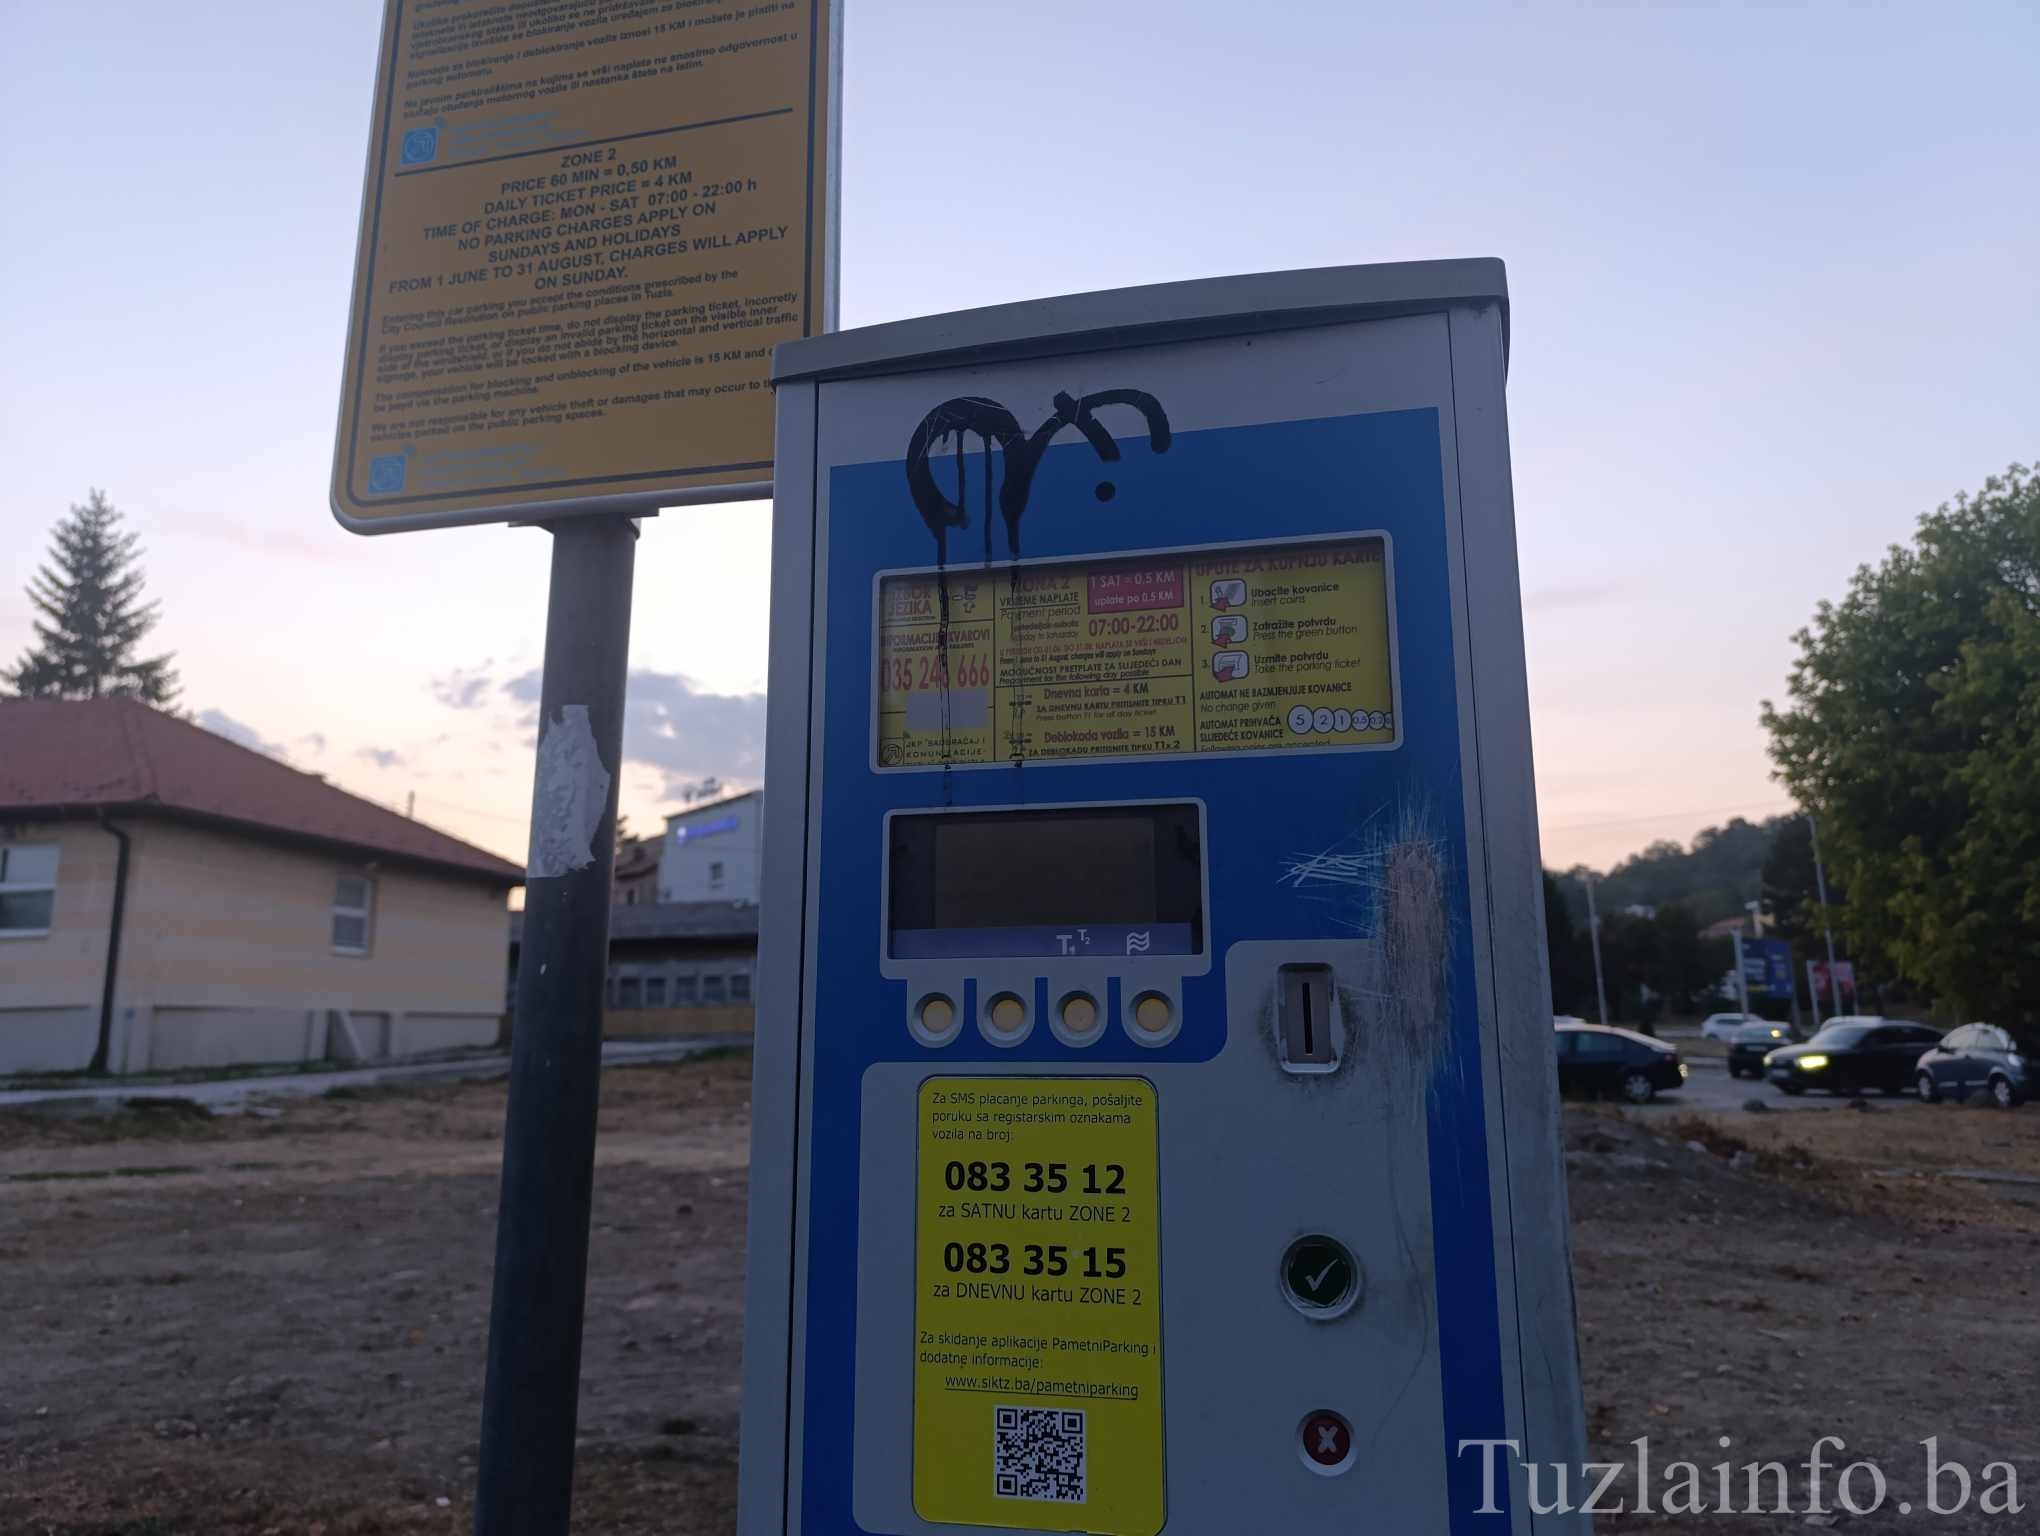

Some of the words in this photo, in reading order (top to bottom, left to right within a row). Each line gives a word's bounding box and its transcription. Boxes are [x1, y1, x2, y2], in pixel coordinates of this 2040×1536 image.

[560, 148, 605, 168] ZONE
[608, 147, 616, 160] 2
[500, 176, 545, 195] PRICE
[550, 172, 567, 187] 60
[571, 167, 599, 184] MIN
[653, 155, 676, 171] KM
[484, 195, 527, 215] DAILY
[532, 186, 585, 208] TICKET
[590, 179, 636, 199] PRICE
[653, 175, 663, 188] 4
[667, 170, 692, 186] KM
[422, 222, 457, 241] TIME
[461, 219, 481, 235] OF
[486, 207, 554, 231] CHARGE:
[560, 202, 595, 220] MON
[609, 195, 639, 212] SAT
[647, 188, 687, 207] 07:00
[702, 179, 742, 199] 22:00
[747, 177, 757, 191] h
[457, 236, 480, 251] NO
[484, 225, 552, 248] PARKING
[556, 213, 632, 237] CHARGES
[638, 205, 689, 225] APPLY
[692, 201, 716, 217] ON
[487, 240, 560, 264] SUNDAYS
[564, 235, 597, 252] AND
[601, 223, 680, 248] HOLIDAYS
[388, 275, 432, 294] FROM
[436, 274, 443, 286] 1
[448, 267, 488, 286] JUNE
[492, 264, 512, 279] TO
[516, 261, 533, 276] 31
[608, 238, 688, 263] CHARGES
[692, 232, 731, 251] WILL
[735, 224, 788, 246] APPLY
[534, 275, 556, 291] ON
[561, 264, 629, 287] SUNDAY.
[622, 332, 639, 343] the
[641, 325, 695, 340] horizontal
[702, 322, 719, 332] and
[722, 316, 763, 330] vertical
[766, 312, 798, 324] traffic
[618, 363, 630, 374] of
[632, 361, 649, 372] the
[652, 357, 691, 369] vehicle
[708, 352, 720, 362] 15
[723, 350, 741, 361] KM
[744, 347, 764, 358] and
[597, 398, 608, 407] or
[611, 392, 660, 406] damages
[663, 388, 685, 398] that
[687, 386, 709, 397] may
[714, 383, 745, 393] occur
[749, 380, 760, 390] to
[1101, 575, 1121, 587] SAT
[1134, 572, 1152, 585] 0.5
[1156, 571, 1175, 583] KM
[1292, 582, 1340, 595] kovanice
[1127, 595, 1140, 605] po
[1142, 592, 1156, 602] 0.5
[1158, 590, 1174, 601] KM
[1088, 613, 1179, 637] 07:00-22:00
[1277, 629, 1294, 639] the
[1295, 628, 1324, 640] green
[1325, 624, 1358, 636] button
[1297, 616, 1336, 629] potvrdu
[1104, 661, 1117, 671] ZA
[1161, 658, 1182, 667] DAN
[1289, 650, 1329, 663] potvrdu
[1296, 659, 1332, 673] parking
[957, 653, 991, 688] 666
[1132, 682, 1149, 694] KM
[1200, 689, 1238, 701] AUTOMAT
[1239, 688, 1250, 698] NE
[1308, 682, 1353, 694] KOVANICE
[1215, 701, 1250, 714] change
[1200, 718, 1239, 730] AUTOMAT
[1043, 729, 1099, 744] Deblokada
[1144, 726, 1157, 739] 15
[1159, 725, 1176, 737] KM
[1240, 729, 1284, 741] KOVANICE
[932, 1093, 946, 1104] Za
[951, 1093, 975, 1105] SMS
[1032, 1093, 1088, 1108] parkinga,
[1092, 1094, 1142, 1109] pošaljite
[932, 1111, 972, 1124] poruku
[977, 1112, 989, 1121] sa
[994, 1112, 1065, 1125] registarskim
[1070, 1112, 1131, 1124] oznakama
[932, 1129, 964, 1139] vozila
[969, 1130, 982, 1139] na
[945, 1161, 1010, 1191] 083
[1024, 1162, 1068, 1193] 35
[1082, 1164, 1126, 1194] 12
[938, 1206, 954, 1217] za
[961, 1203, 1015, 1219] SATNU
[1022, 1204, 1063, 1221] kartu
[1069, 1206, 1115, 1222] ZONE
[1122, 1207, 1131, 1222] 2
[944, 1242, 1010, 1274] 083
[1024, 1245, 1068, 1276] 35
[1083, 1247, 1126, 1278] 15
[933, 1285, 950, 1297] za
[957, 1282, 1025, 1299] DNEVNU
[1032, 1285, 1073, 1302] kartu
[1080, 1287, 1125, 1304] ZONE
[1132, 1289, 1142, 1305] 2
[920, 1332, 933, 1344] Za
[938, 1333, 987, 1348] skidanje
[992, 1336, 1048, 1350] aplikacije
[1053, 1338, 1148, 1356] PametniParking
[920, 1352, 967, 1365] dodatne
[972, 1354, 1043, 1370] informacije:
[946, 1376, 1138, 1399] www.siktz.ba/pametniparking
